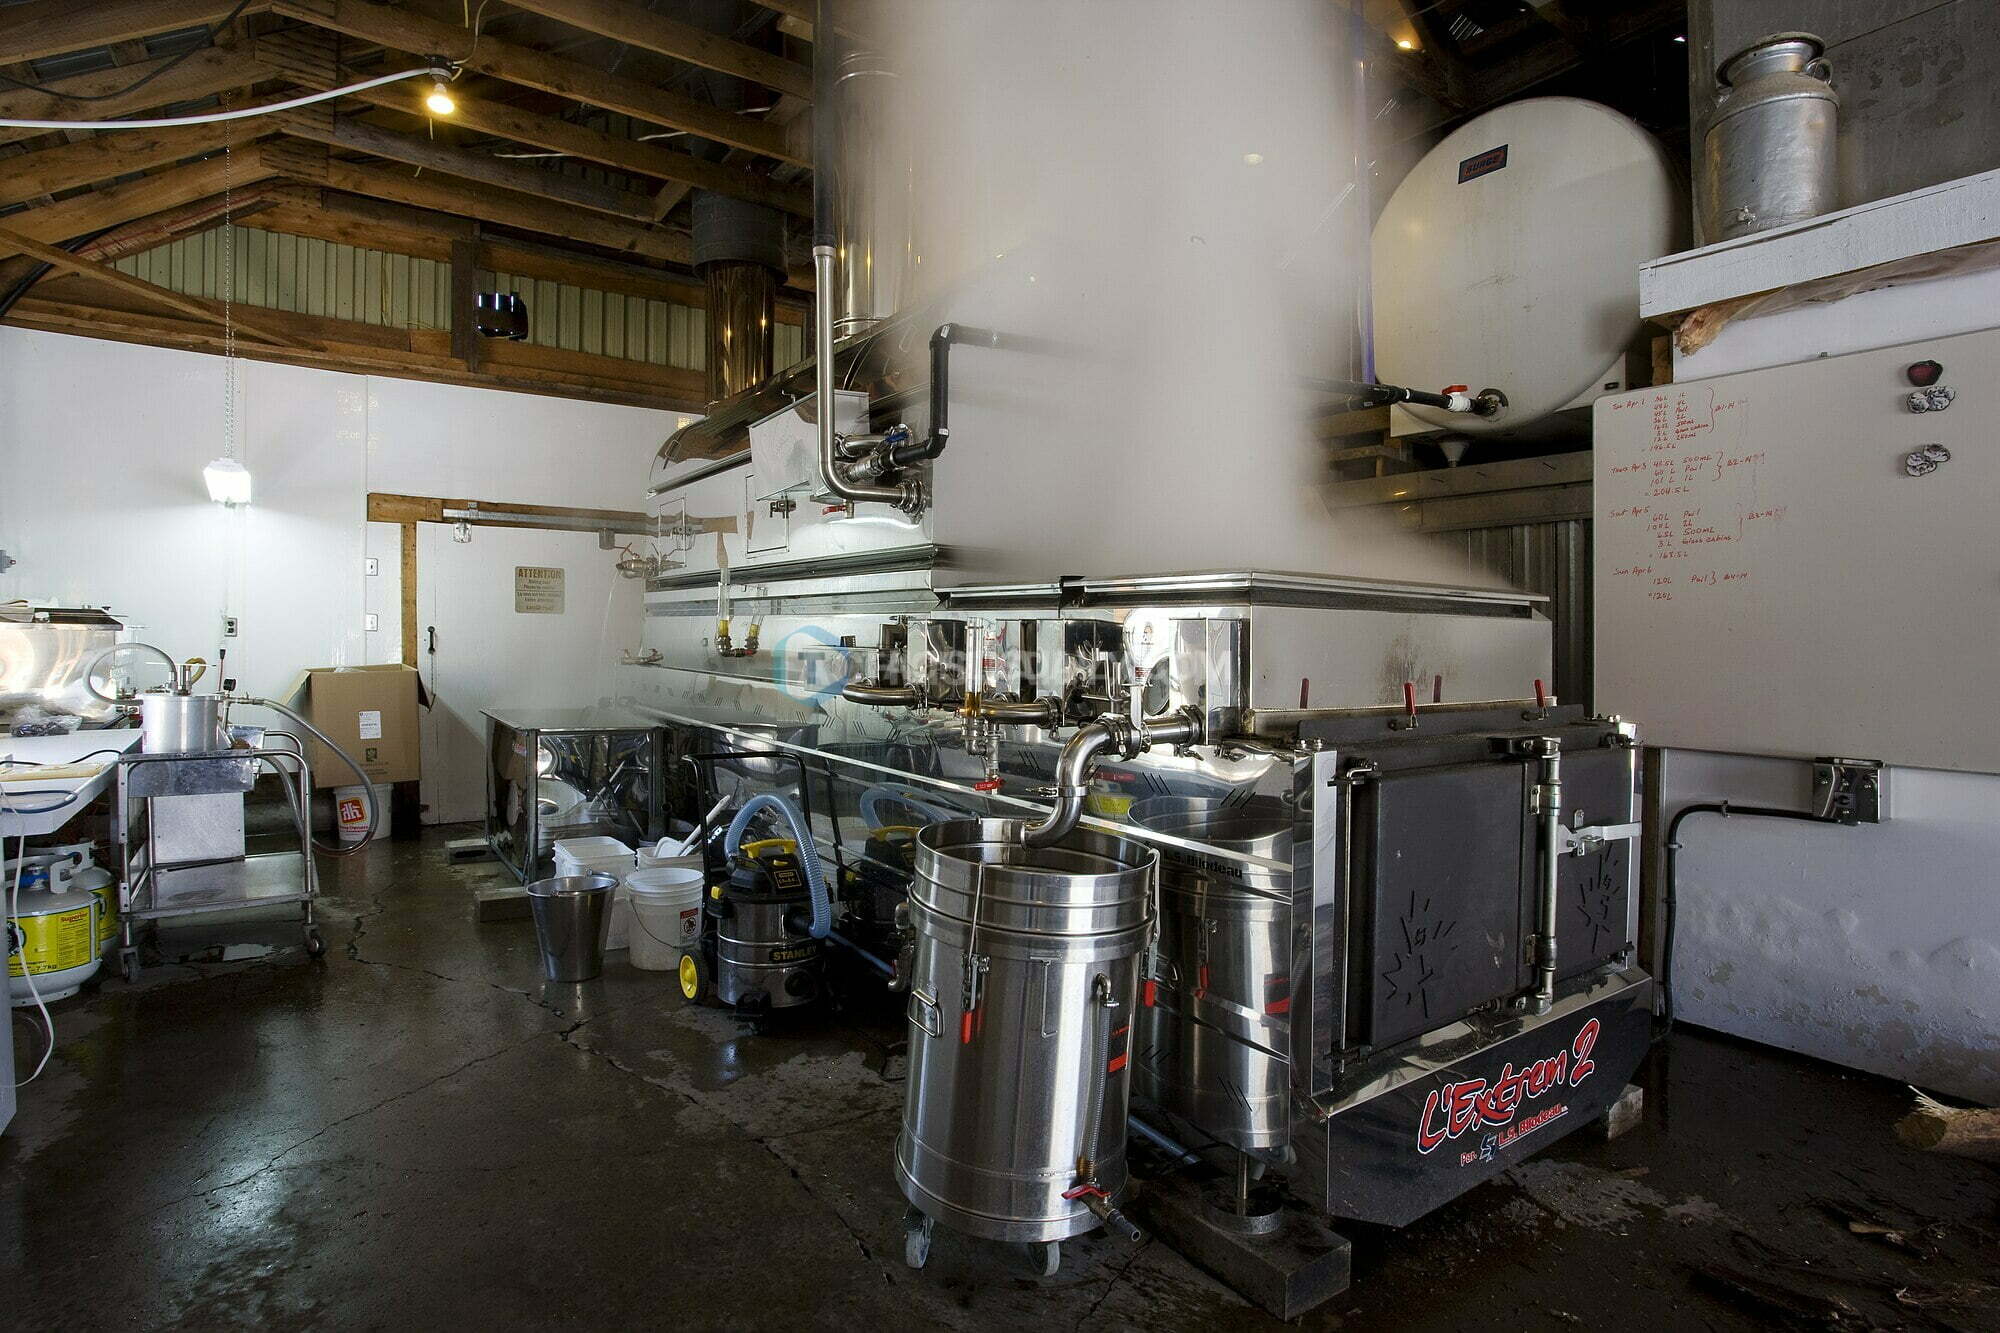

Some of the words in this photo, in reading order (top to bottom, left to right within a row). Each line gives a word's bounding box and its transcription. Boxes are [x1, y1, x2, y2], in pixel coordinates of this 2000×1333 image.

[518, 567, 561, 579] ATTENTION
[772, 944, 817, 961] STANLEY
[1570, 1017, 1601, 1088] 2
